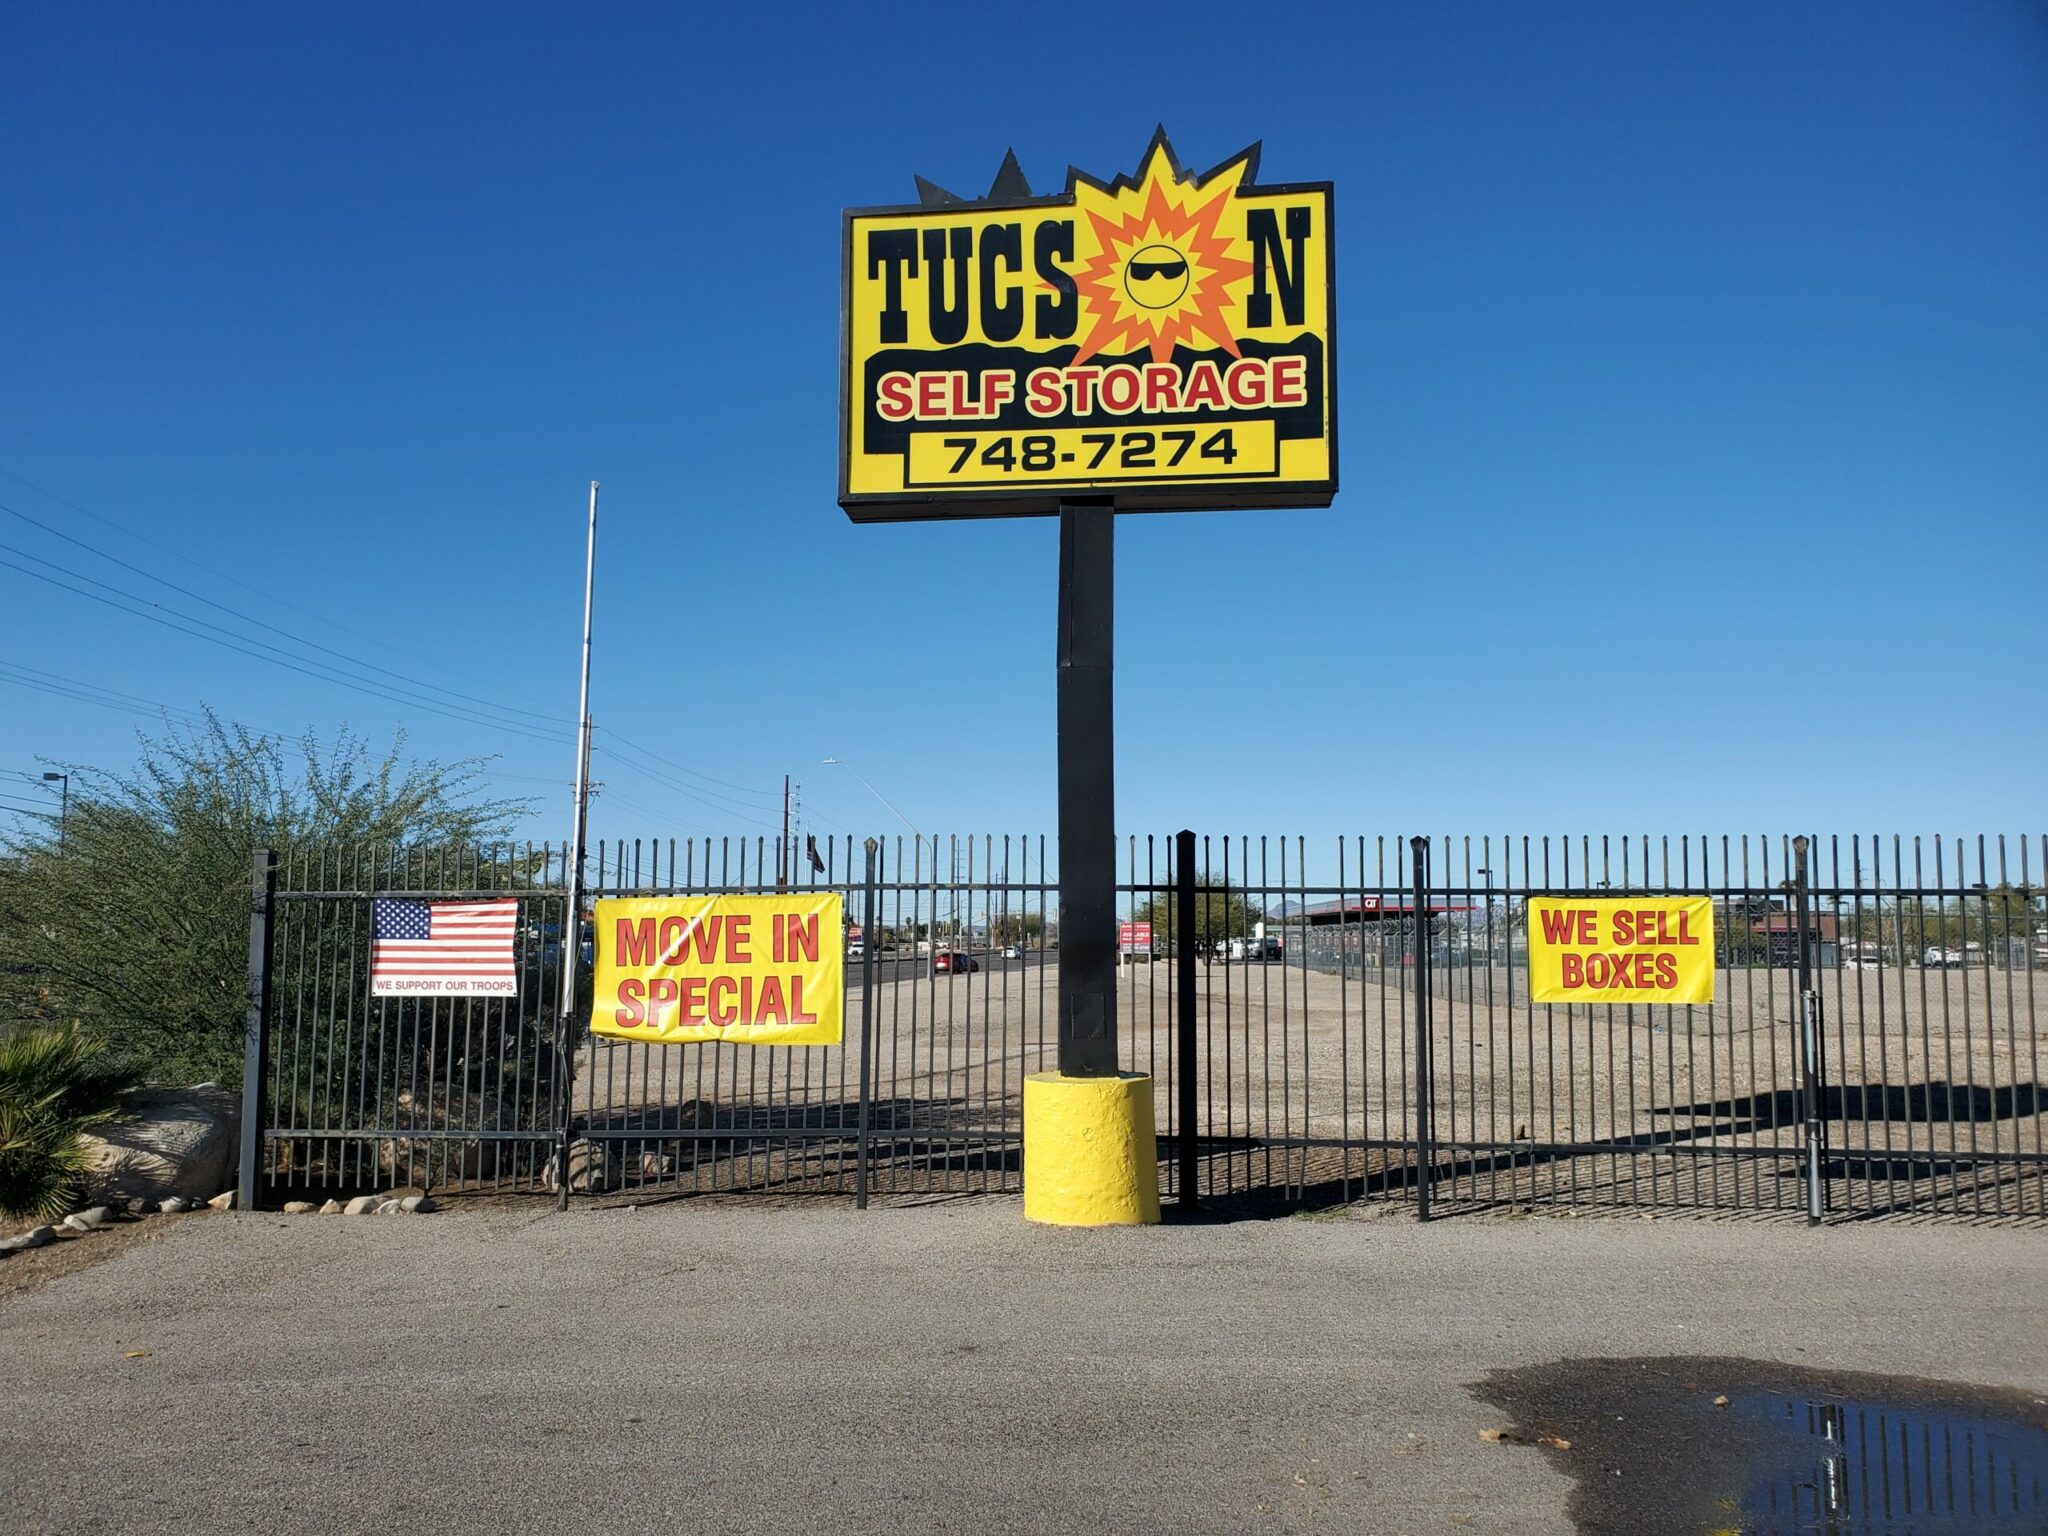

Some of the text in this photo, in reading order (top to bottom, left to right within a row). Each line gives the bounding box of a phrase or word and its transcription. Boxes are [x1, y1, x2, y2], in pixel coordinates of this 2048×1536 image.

[877, 356, 1306, 422] SELF STORAGE
[943, 429, 1238, 474] 748-7274
[1365, 899, 1377, 908] QT
[616, 913, 819, 967] MOVE IN
[1540, 909, 1700, 946] WE SELL
[376, 980, 513, 991] WE SUPPORT OUR TROOPS
[1562, 953, 1678, 989] BOXES
[615, 975, 817, 1028] SPECIAL
